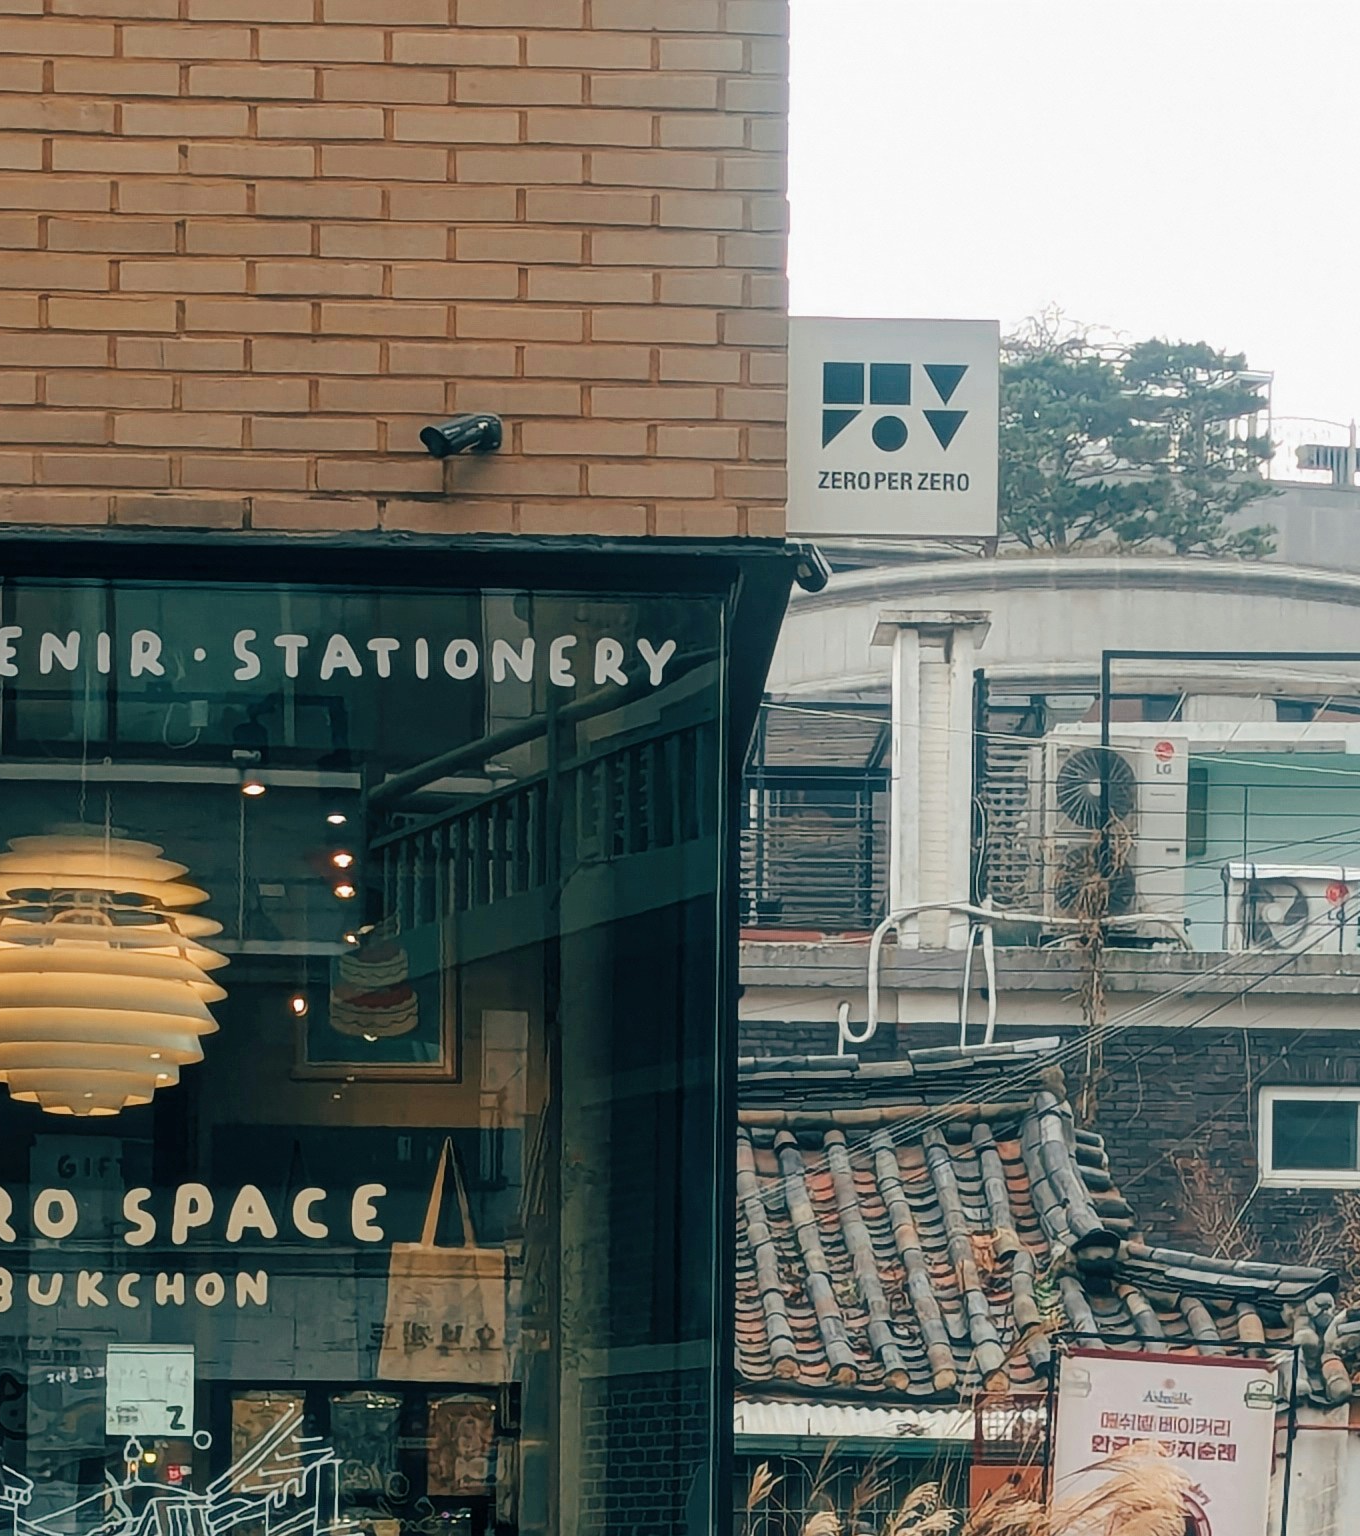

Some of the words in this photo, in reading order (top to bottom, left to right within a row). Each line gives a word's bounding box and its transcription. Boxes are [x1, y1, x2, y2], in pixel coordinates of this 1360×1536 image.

[818, 471, 870, 490] ZERO
[874, 472, 913, 490] PER
[917, 473, 970, 491] ZERO
[232, 629, 677, 688] STATIONERY
[1156, 764, 1172, 775] LG
[122, 1183, 387, 1246] SPACE
